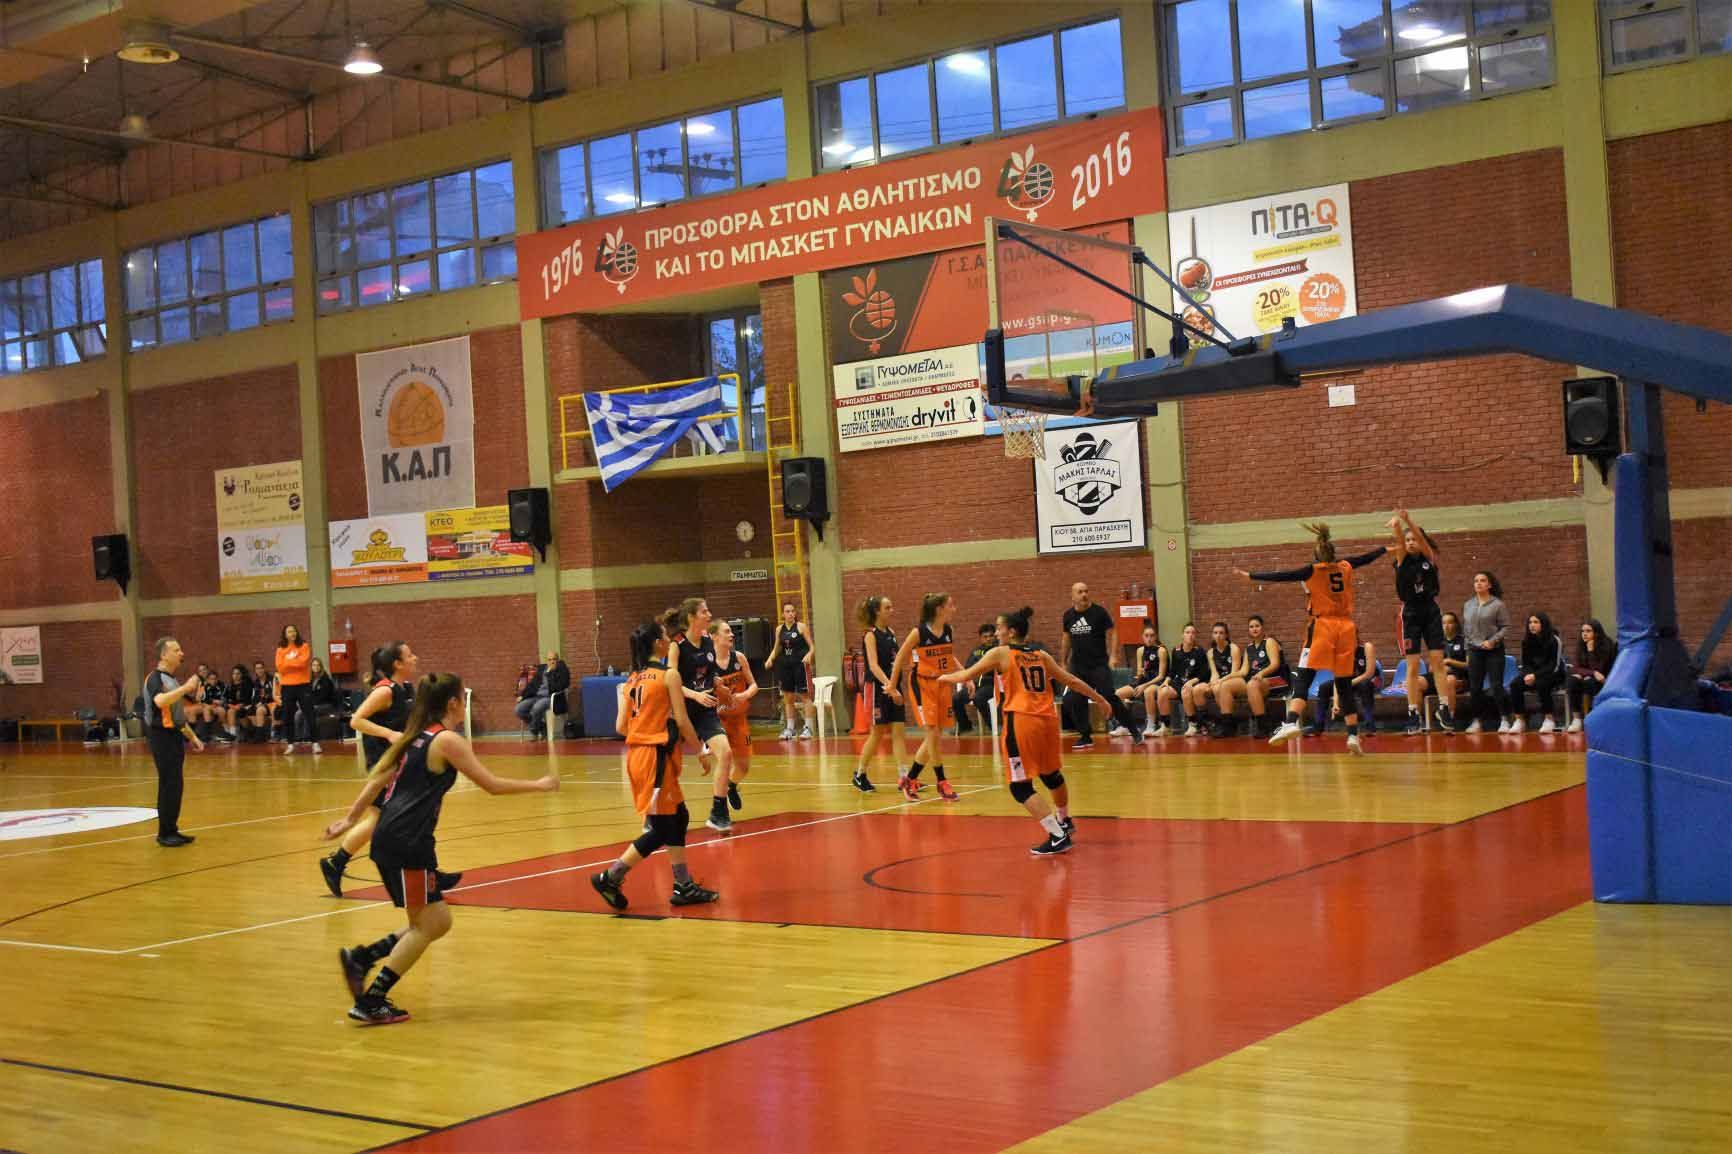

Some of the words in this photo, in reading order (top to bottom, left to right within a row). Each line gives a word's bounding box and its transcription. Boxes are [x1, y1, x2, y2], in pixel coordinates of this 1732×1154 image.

[1071, 131, 1132, 212] 2016
[645, 209, 764, 249] ΠΡΟΣΦΟΡΑ
[769, 195, 829, 227] ΣΤΟΝ
[837, 166, 982, 214] ΑΘΛΗΤΙΣΜΟ
[655, 254, 692, 280] ΚΑΙ
[697, 249, 725, 272] ΤΟ
[730, 225, 838, 268] ΜΠΑΣΚΕΤ
[845, 202, 973, 247] ΓΥΝΑΙΚΩΝ
[541, 239, 583, 301] 1976
[853, 406, 896, 422] ΣΥΣΤΗΜΑΤΑ
[911, 397, 957, 428] dryvit
[1328, 572, 1345, 593] 5
[1070, 624, 1093, 633] adidas
[1019, 665, 1046, 693] 10
